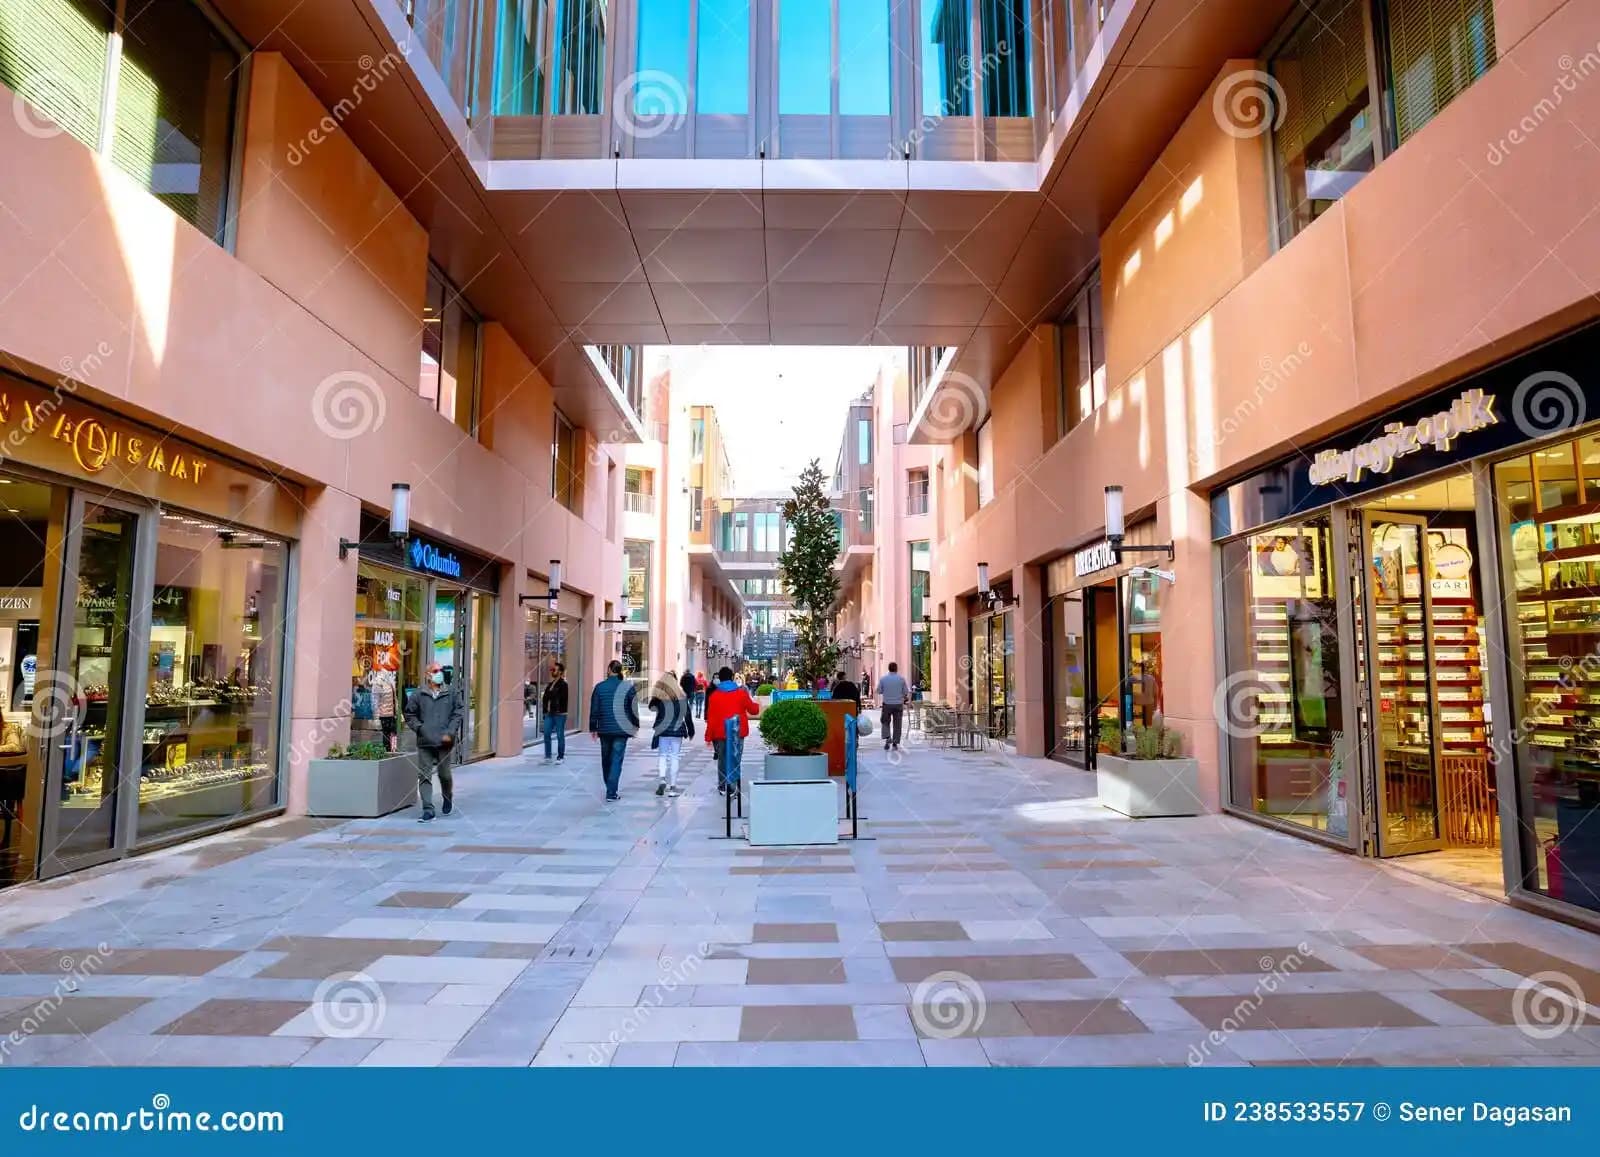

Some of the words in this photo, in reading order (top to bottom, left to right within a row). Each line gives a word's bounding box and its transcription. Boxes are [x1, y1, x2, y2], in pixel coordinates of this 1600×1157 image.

[423, 543, 461, 577] Columbia
[374, 631, 393, 645] MADE
[376, 651, 391, 665] FOR
